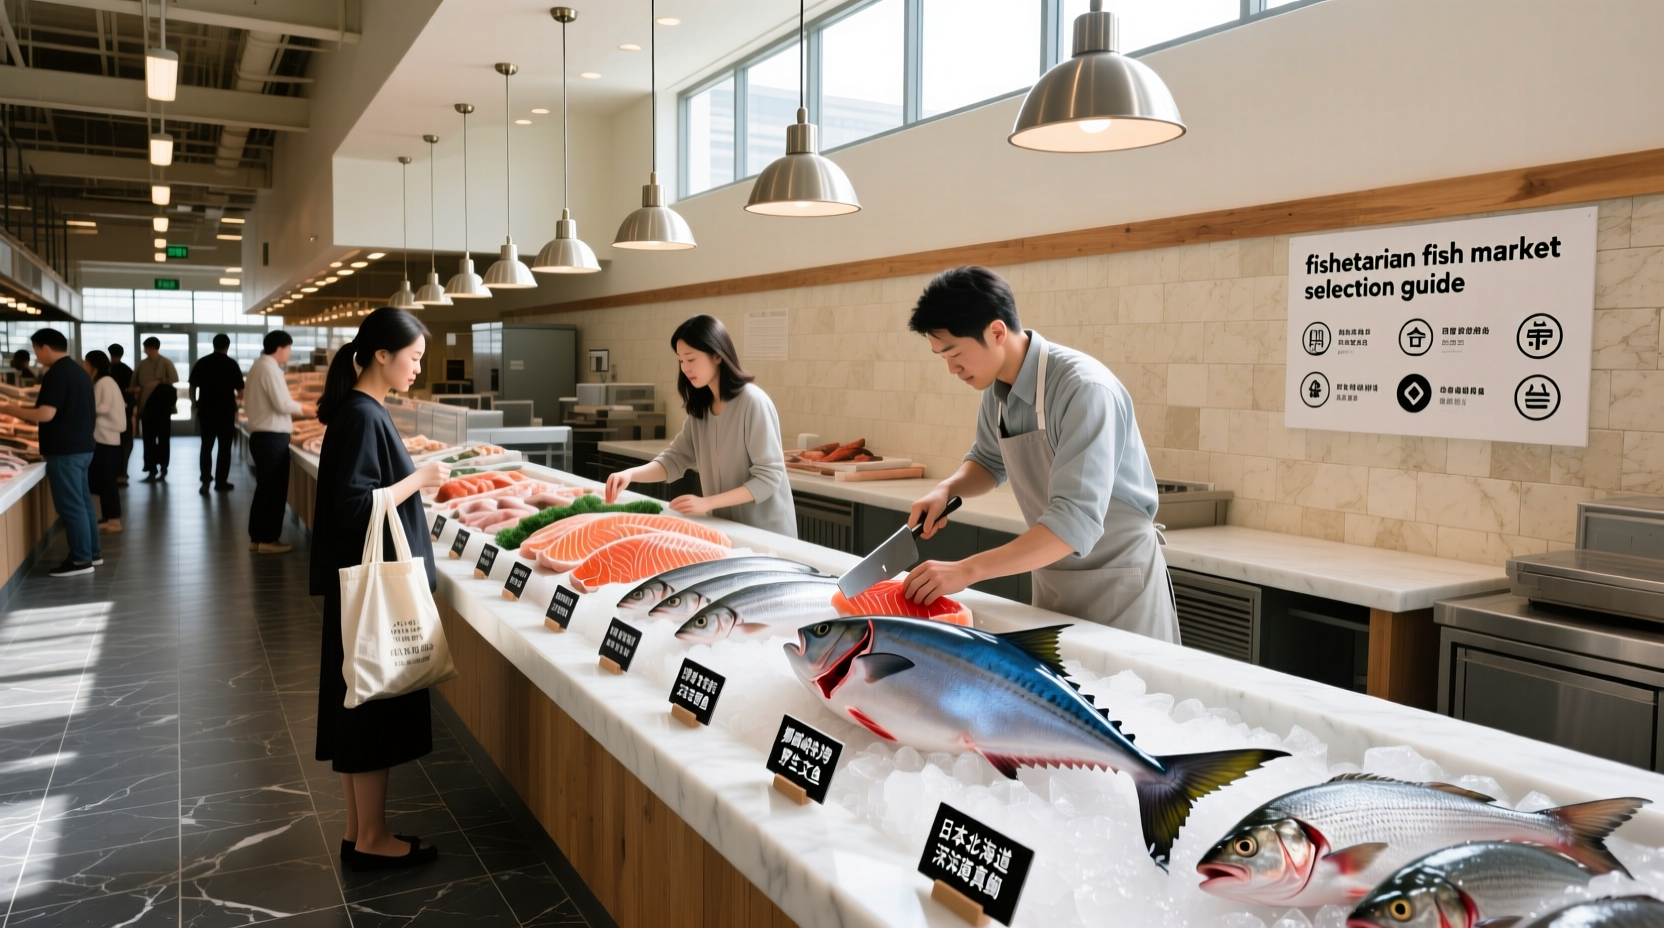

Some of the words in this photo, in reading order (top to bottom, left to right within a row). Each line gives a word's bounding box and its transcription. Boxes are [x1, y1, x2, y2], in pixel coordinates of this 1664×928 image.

[1305, 248, 1416, 275] fishetarian
[1422, 241, 1464, 266] fish
[1470, 236, 1562, 263] market
[1304, 276, 1395, 300] selection
[1400, 271, 1466, 301] guide
[938, 818, 1013, 875] 日本北海道
